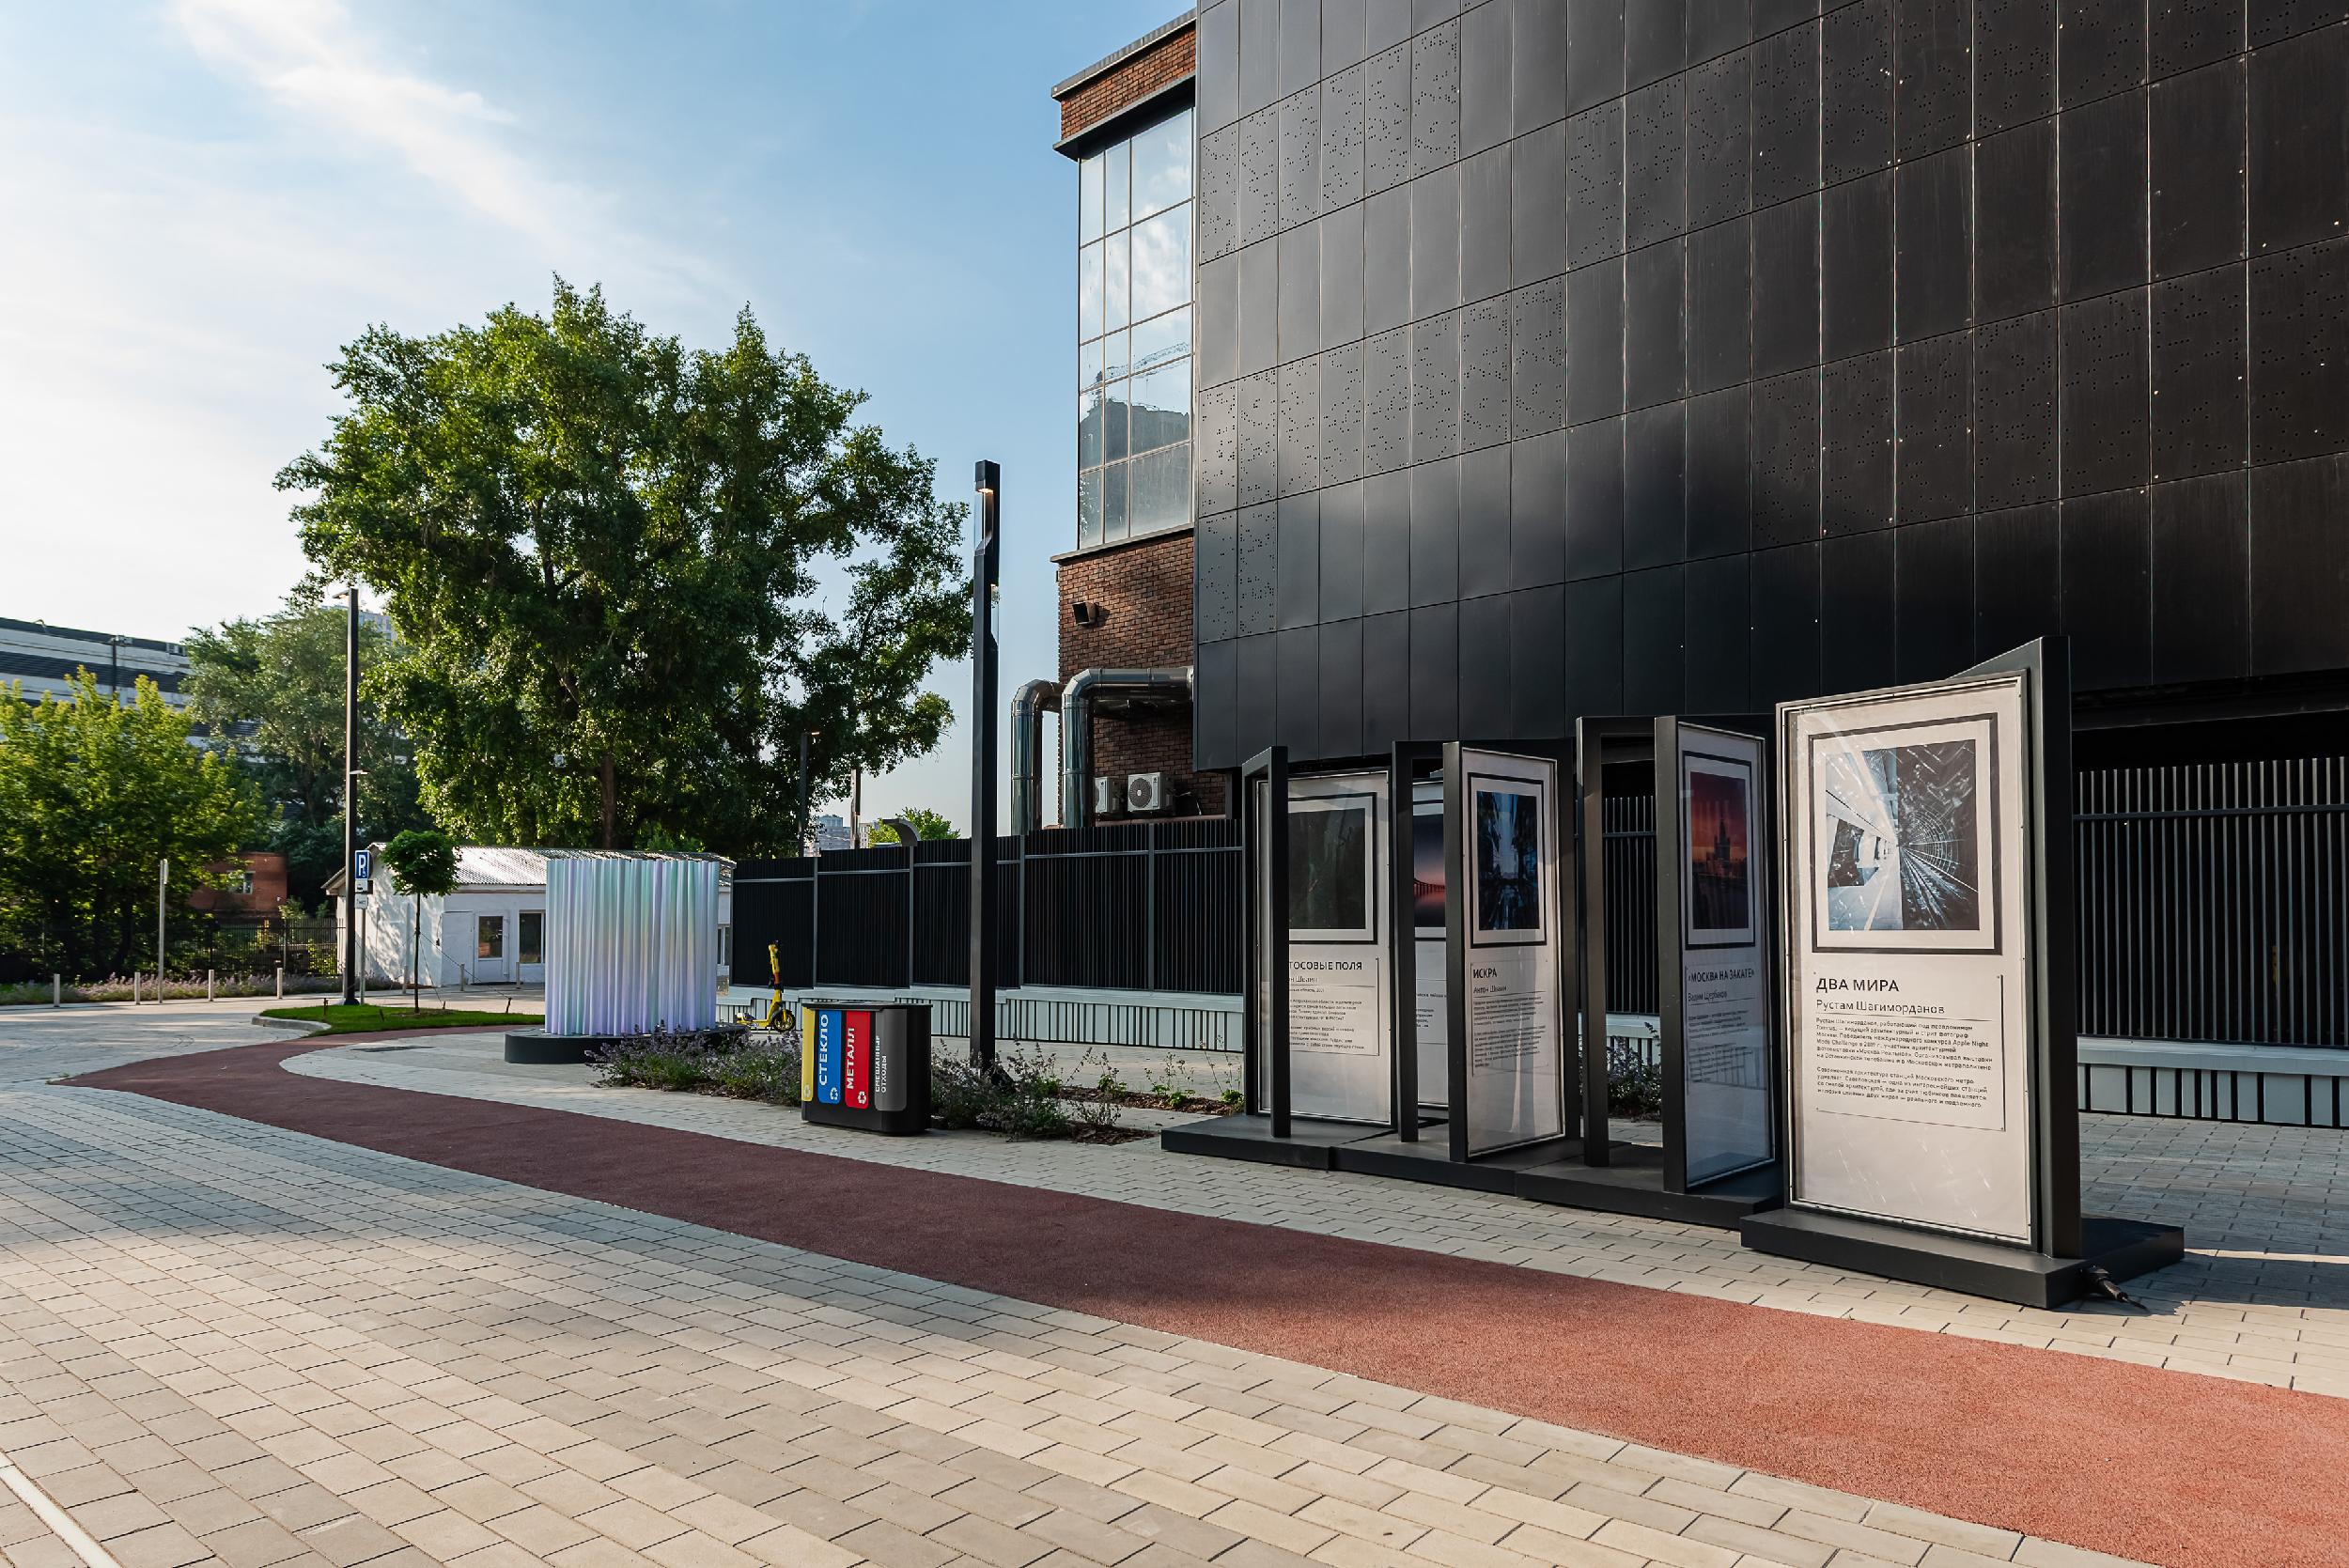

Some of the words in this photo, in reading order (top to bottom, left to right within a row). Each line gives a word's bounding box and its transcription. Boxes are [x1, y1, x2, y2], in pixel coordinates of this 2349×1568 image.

[358, 854, 366, 877] P
[1335, 961, 1362, 970] ПОЛЯ
[1473, 967, 1498, 979] ИСКРА
[1719, 970, 1729, 981] НА
[1816, 978, 1849, 993] ДВА
[1853, 979, 1899, 992] МИРА
[1816, 999, 1854, 1012] Рустам
[1856, 1001, 1945, 1015] Шагиморданов
[819, 1014, 829, 1086] СТЕКЛО
[847, 1027, 855, 1090] МЕТАЛЛ
